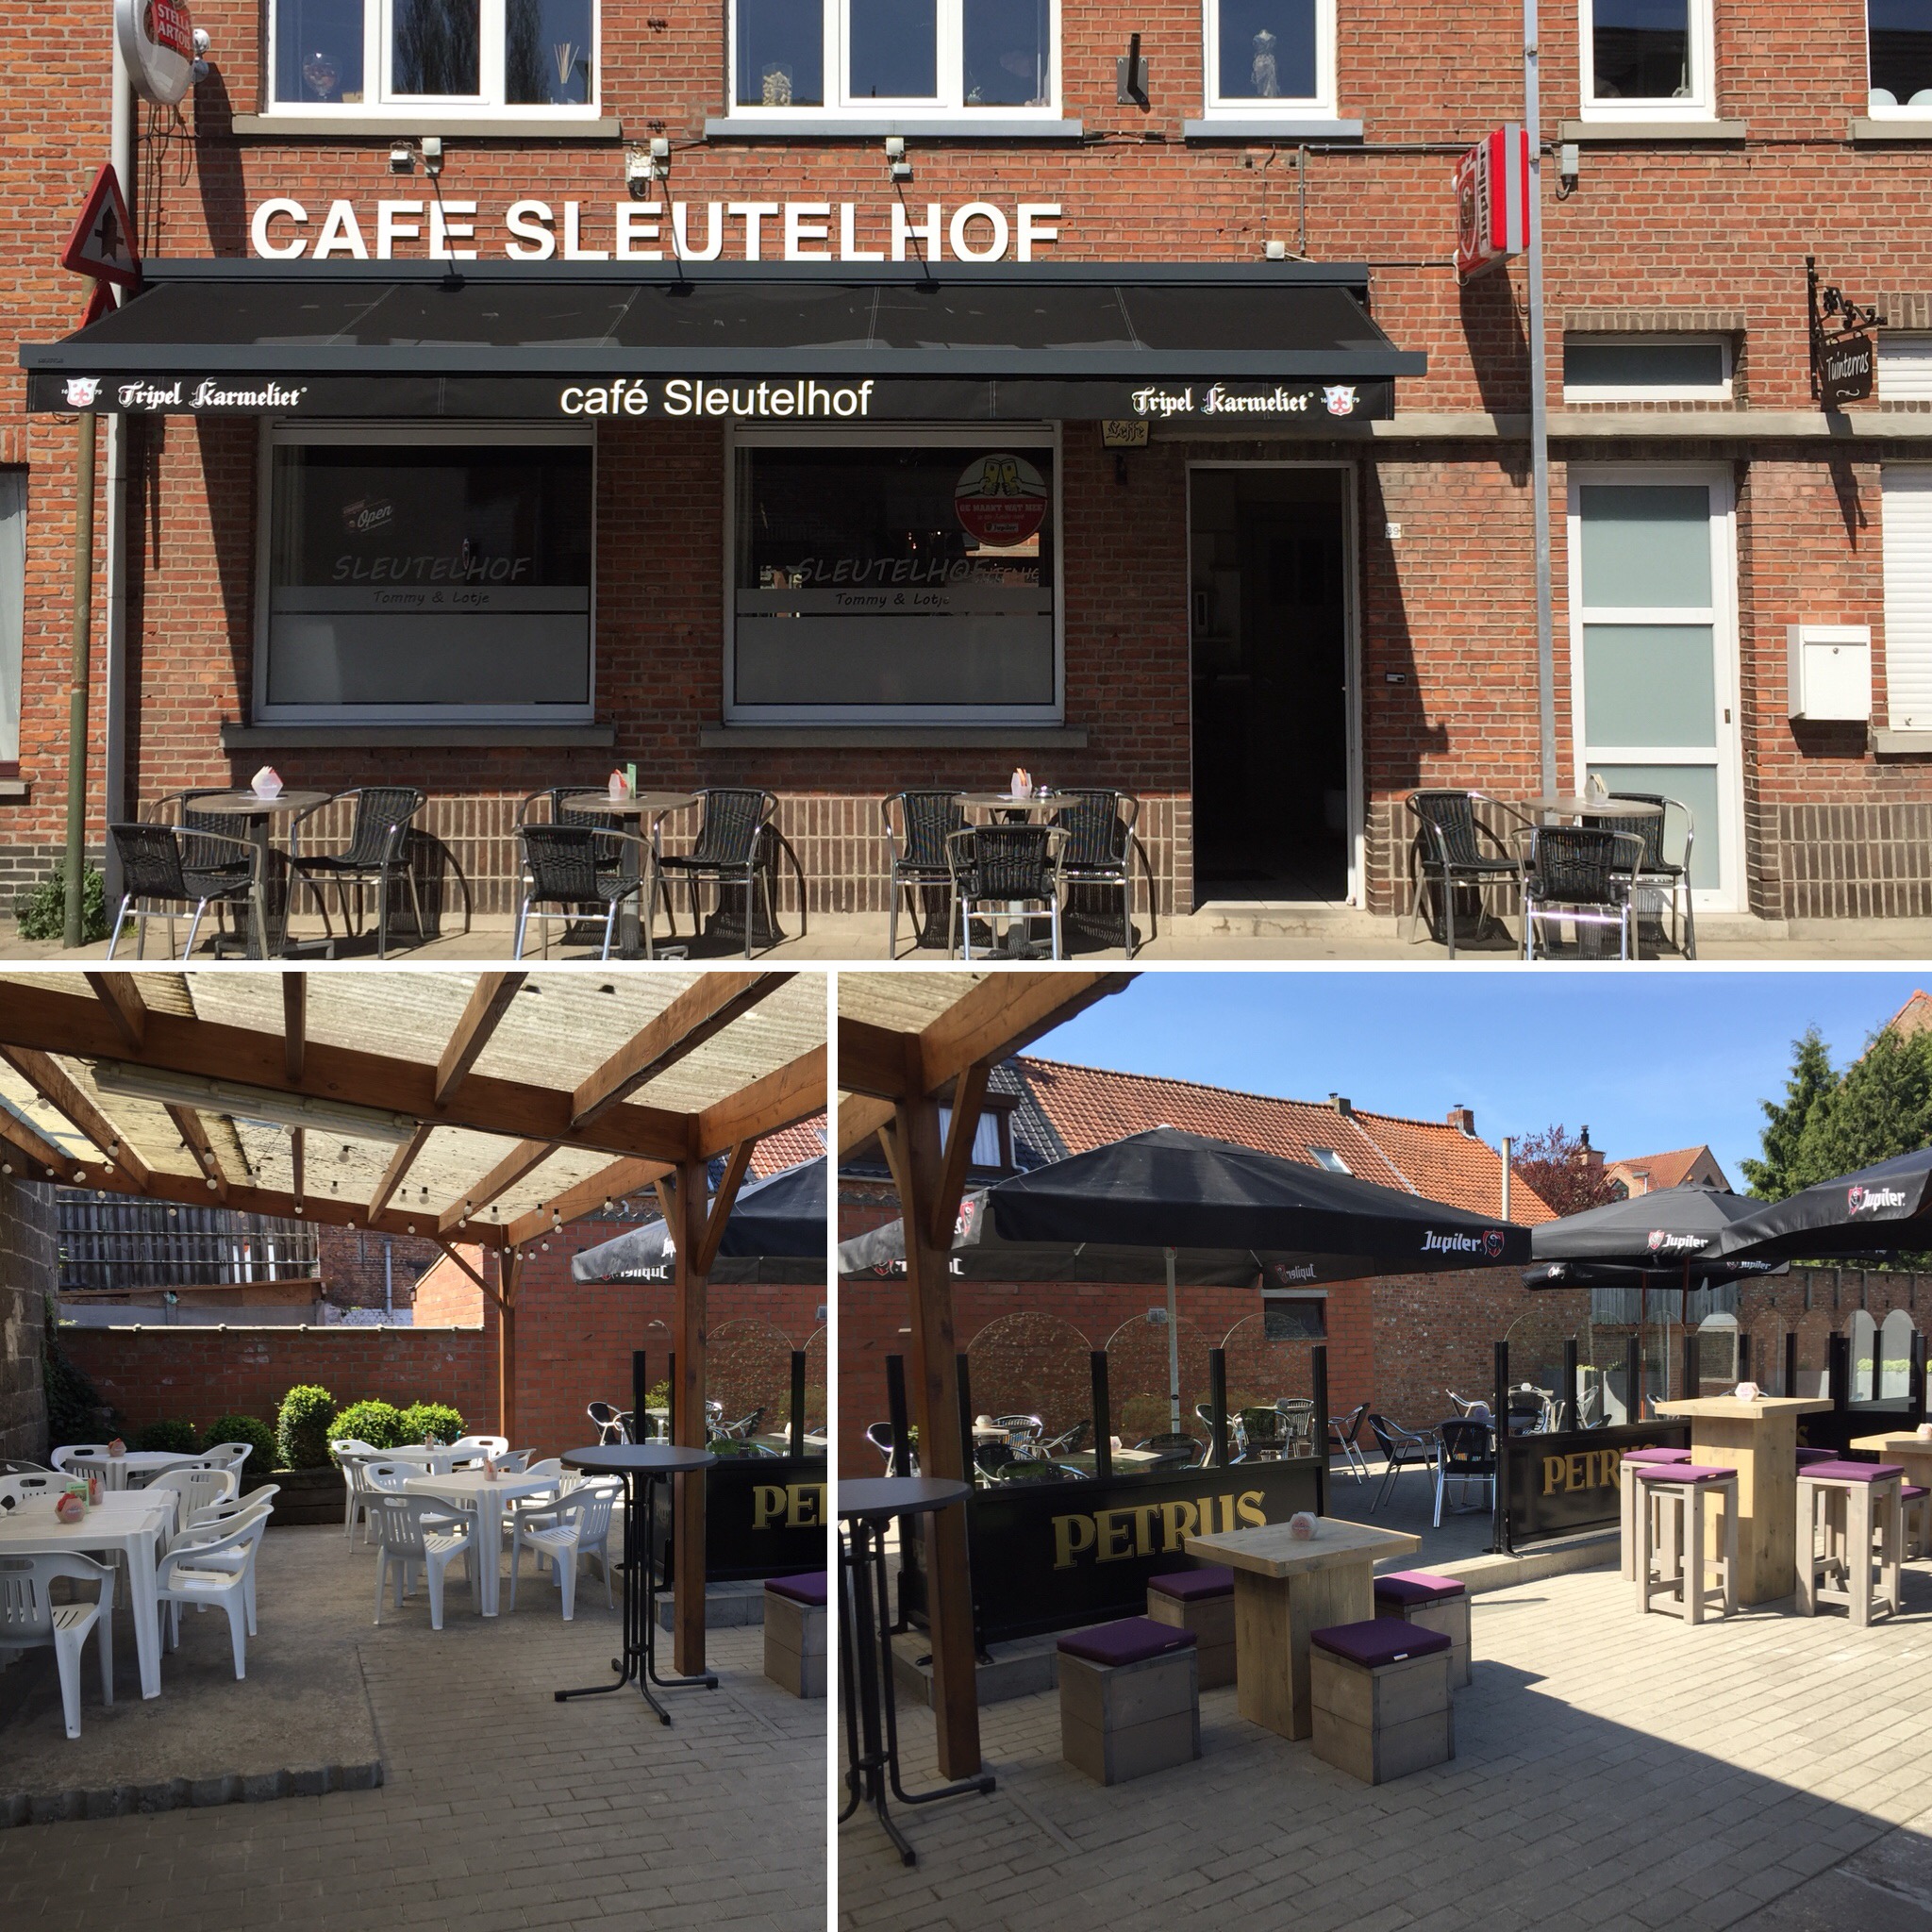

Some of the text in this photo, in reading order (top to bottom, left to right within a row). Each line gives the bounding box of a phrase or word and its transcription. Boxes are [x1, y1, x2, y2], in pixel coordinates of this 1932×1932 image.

[158, 4, 191, 34] STELLA
[251, 198, 1062, 262] CAFE SLEUTELHOF
[1826, 351, 1869, 382] Tuinterras
[118, 377, 300, 411] Tripel Karmeliet
[560, 379, 874, 416] café Sleutelhof
[1132, 382, 1308, 418] Tripel Karmeliet
[1106, 420, 1144, 441] Leffe
[358, 505, 393, 528] Open
[1387, 526, 1399, 536] 39
[332, 555, 531, 581] SLEUTELHOF
[798, 558, 991, 583] SLEUTELHOF
[374, 591, 490, 606] Tommy & Lotje
[836, 592, 887, 608] Tommy
[893, 592, 906, 606] &
[1858, 1188, 1906, 1211] Jupiler
[1420, 1230, 1479, 1254] Jupiler
[1661, 1234, 1708, 1249] Jupiler
[1543, 1443, 1657, 1496] PETR
[1052, 1491, 1267, 1571] PETRUS
